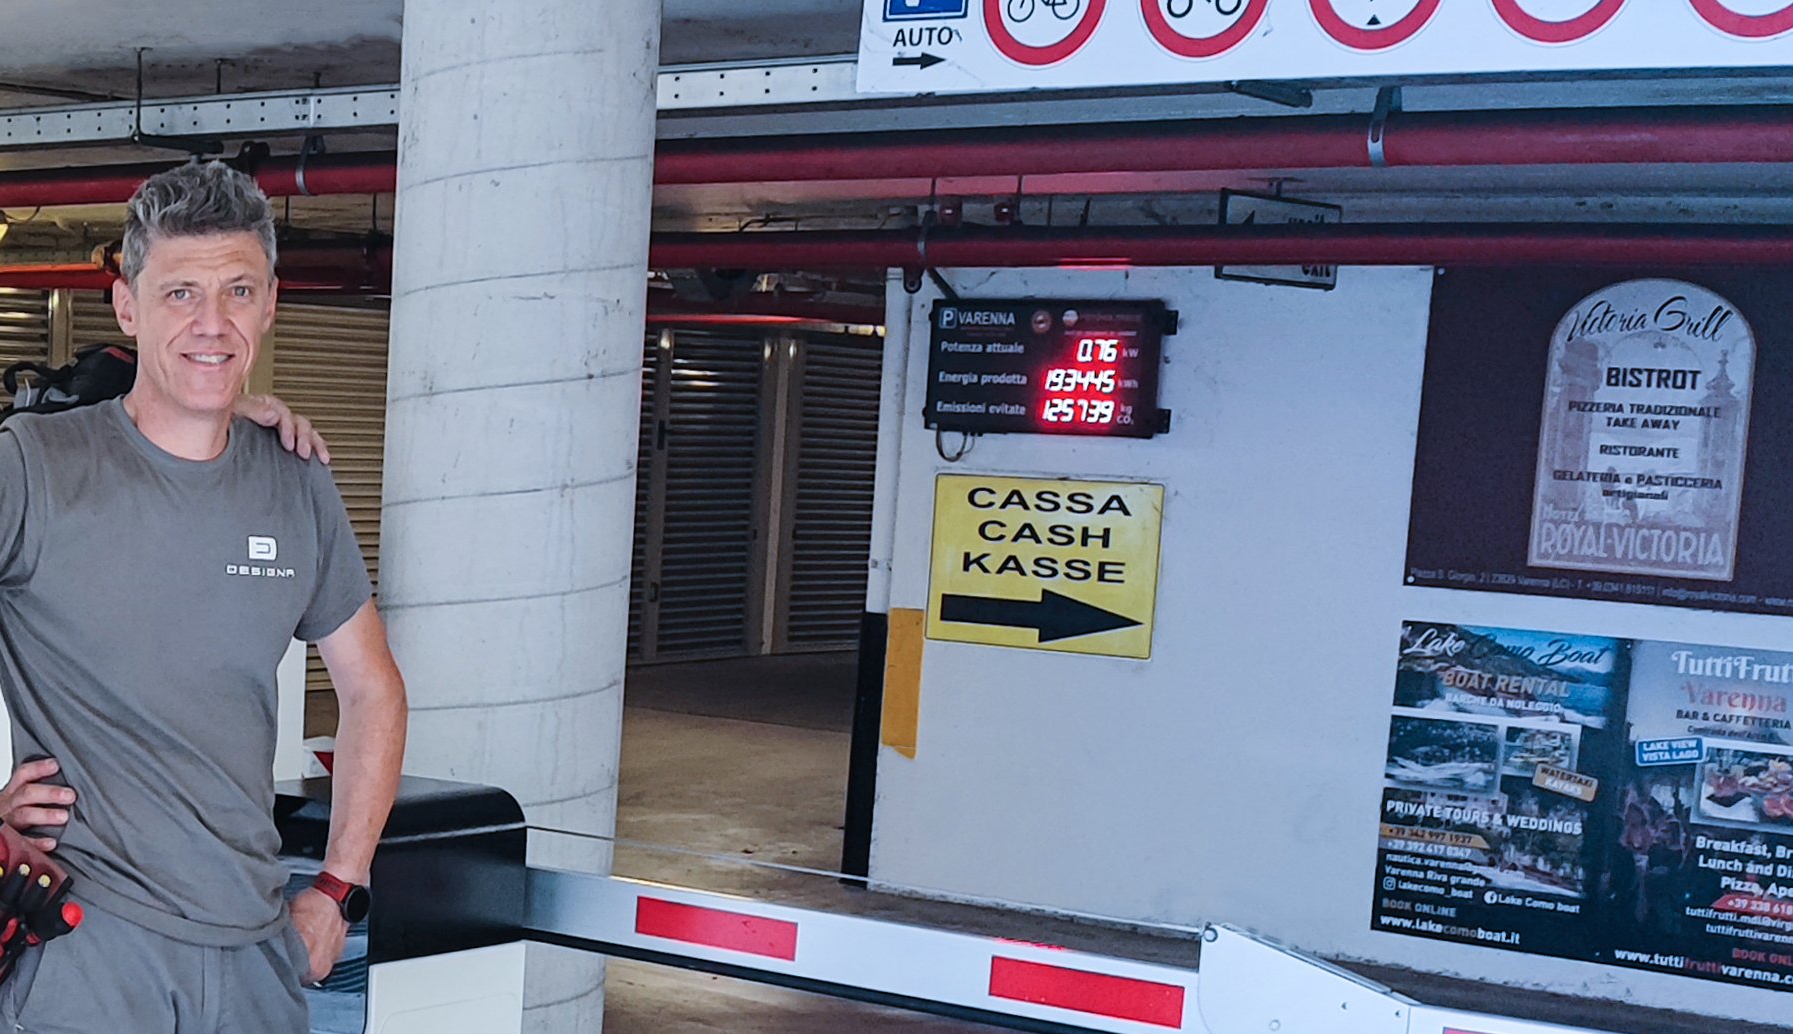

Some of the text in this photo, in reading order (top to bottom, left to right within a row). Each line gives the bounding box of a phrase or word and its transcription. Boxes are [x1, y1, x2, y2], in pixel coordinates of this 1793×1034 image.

[893, 26, 953, 47] AUTO
[959, 312, 1015, 326] VARENNA
[1654, 295, 1733, 342] Grill
[941, 341, 983, 353] Potenza
[986, 341, 1025, 354] attuale
[938, 371, 978, 385] Energia
[981, 372, 1027, 385] prodotta
[1607, 367, 1702, 390] BISTROT
[936, 401, 986, 415] Emissioni
[988, 402, 1026, 416] evitate
[1568, 400, 1722, 418] PIZZERIA TRADIZIONALE
[1606, 417, 1680, 430] TAKE AWAY
[1599, 444, 1680, 459] RISTORANTE
[1553, 470, 1621, 483] GELATERIA
[1636, 473, 1723, 490] PASTICCERIA
[967, 487, 1132, 517] CASSA
[978, 520, 1111, 549] CASH
[226, 564, 295, 577] DESIGNA
[963, 552, 1126, 584] KASSE
[1403, 628, 1465, 657] Lake
[1537, 639, 1610, 666] Boat
[1443, 670, 1570, 697] BOAT RENTAL
[1681, 681, 1786, 712] Varenna
[1676, 709, 1698, 721] BAR
[1713, 713, 1792, 729] CAFFETTERIA
[1643, 739, 1697, 750] LAKE VIEW
[1643, 750, 1699, 762] VISTA LAGO
[1386, 800, 1442, 818] PRIVATE
[1444, 807, 1489, 824] TOURS
[1507, 815, 1583, 836] WEDDINGS
[1695, 835, 1772, 858] Breakfast,
[1385, 864, 1486, 888] Varenna Riva grande
[1698, 854, 1743, 872] Lunch
[1777, 864, 1793, 879] Di
[1382, 898, 1456, 918] BOOK ONLINE
[1498, 893, 1523, 906] Lake
[1525, 897, 1555, 910] Como
[1557, 901, 1580, 914] boat
[1614, 948, 1793, 985] www.tuttifruttivarenna.c
